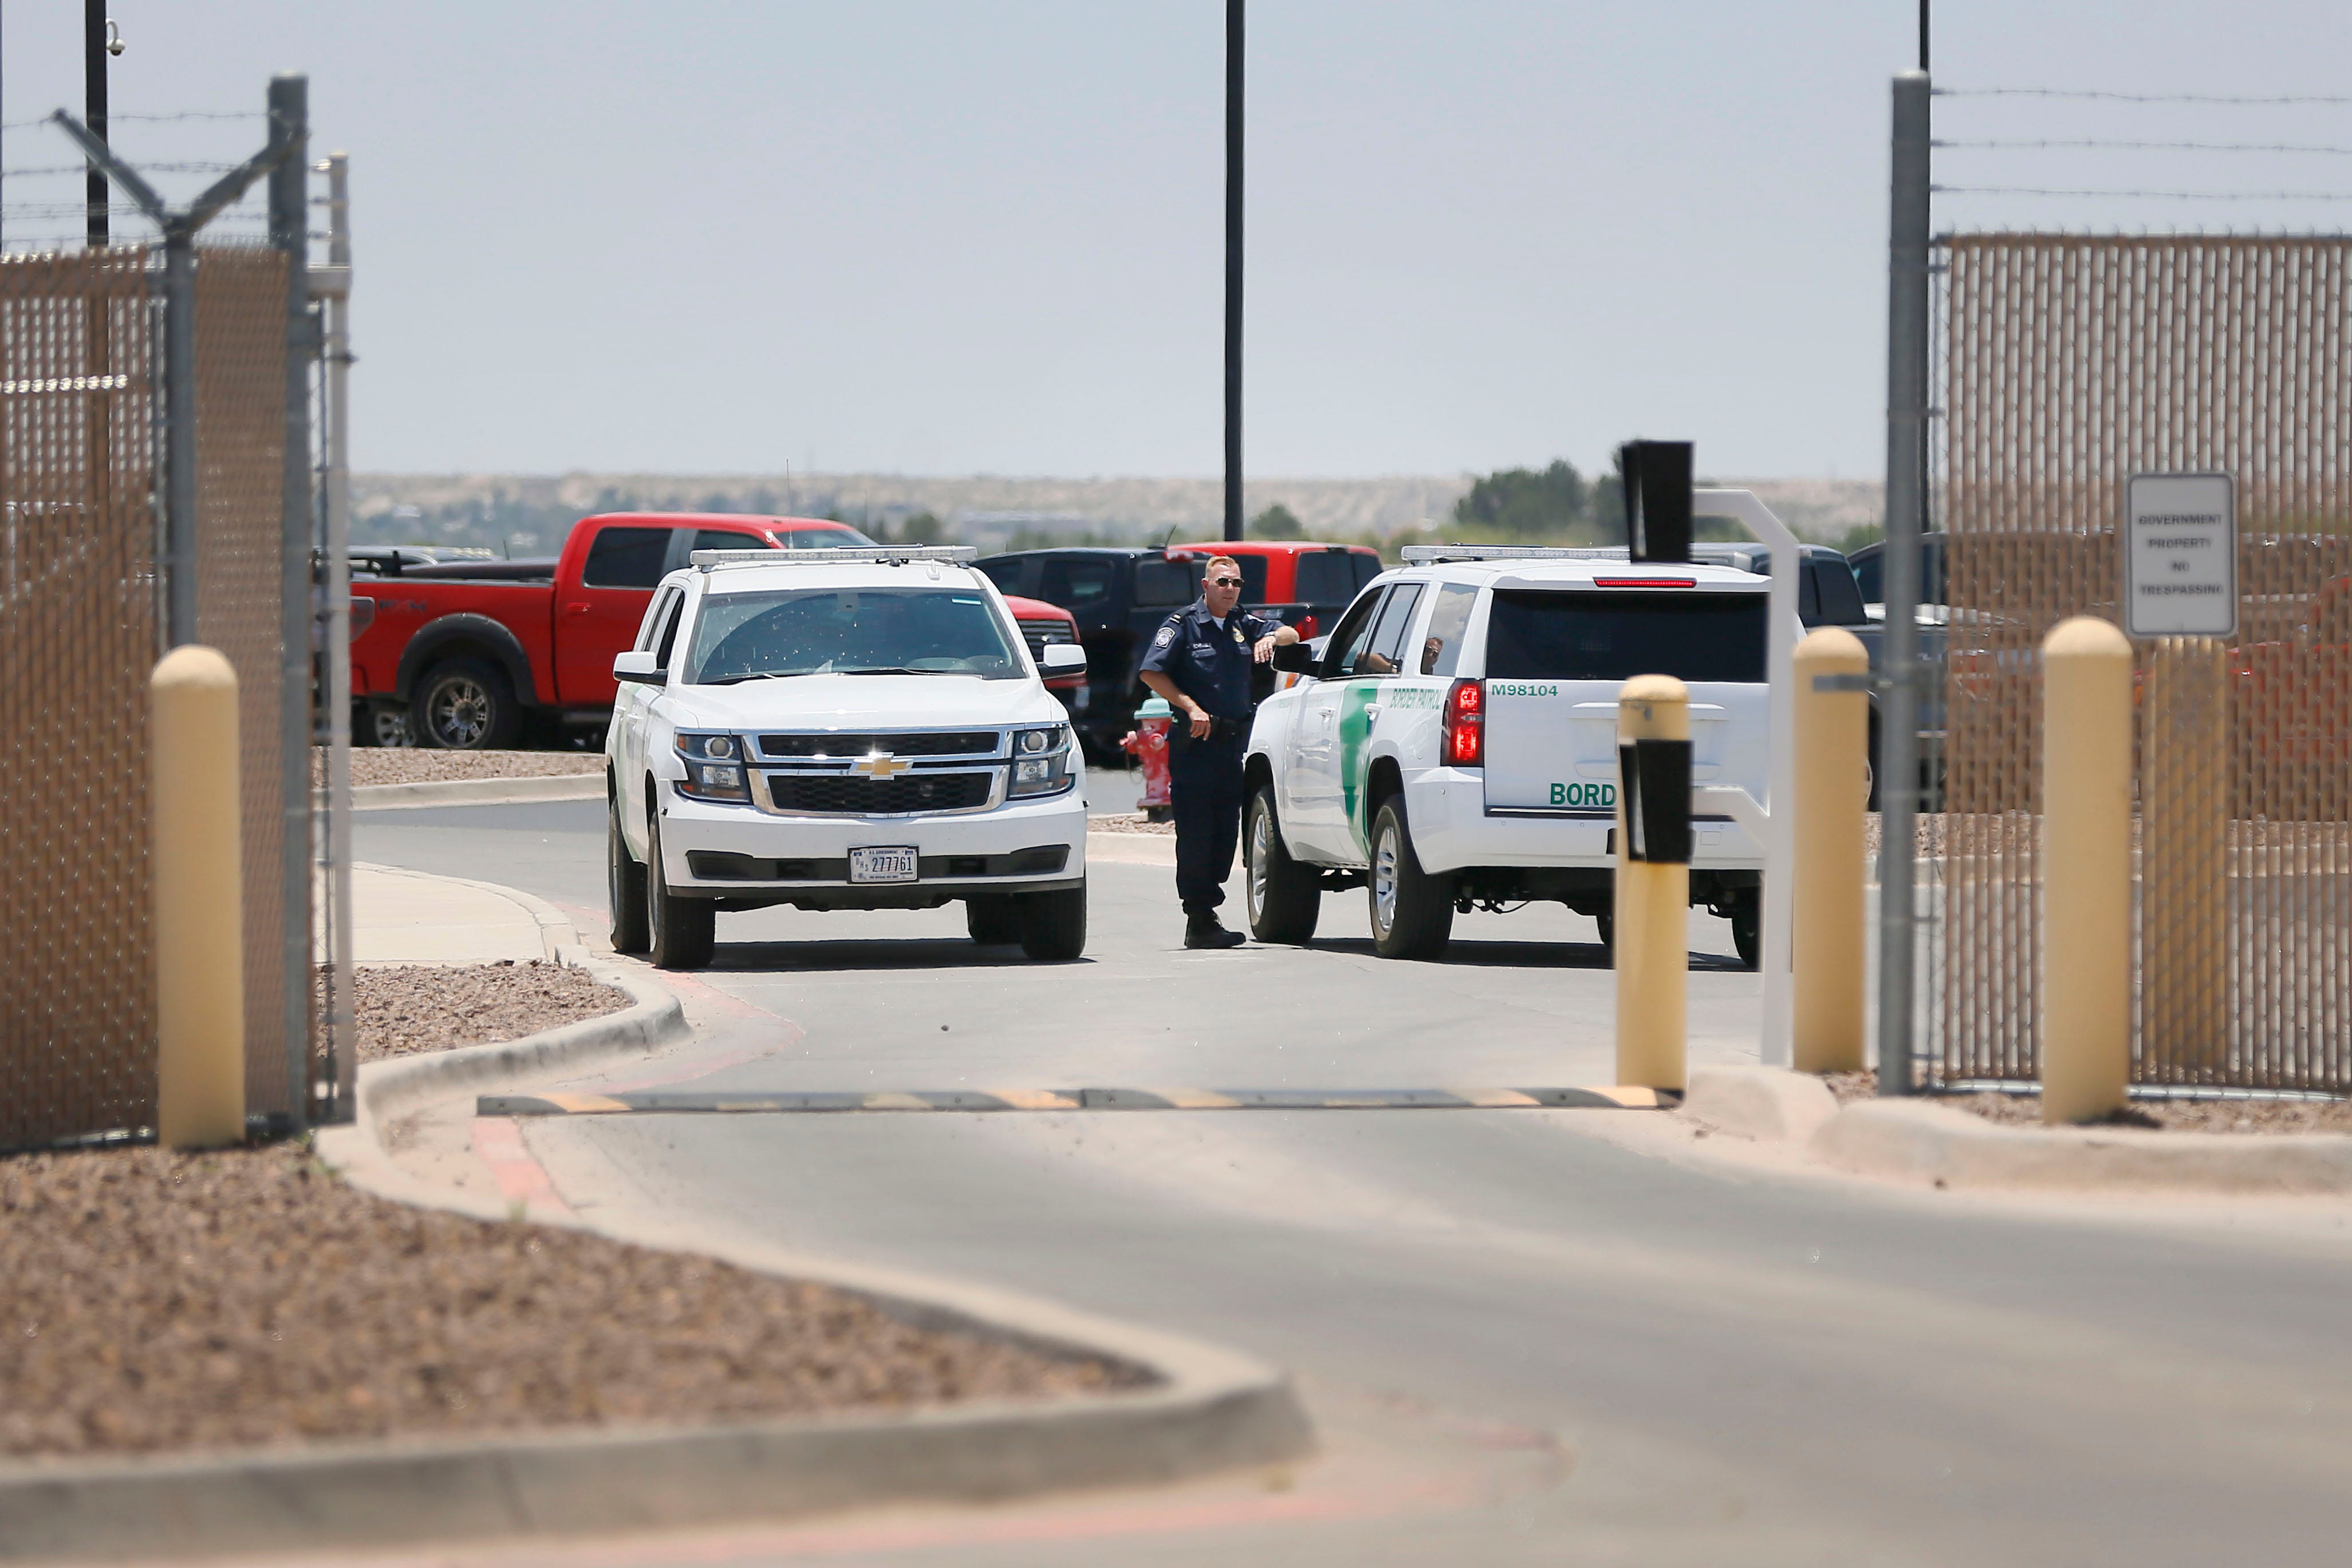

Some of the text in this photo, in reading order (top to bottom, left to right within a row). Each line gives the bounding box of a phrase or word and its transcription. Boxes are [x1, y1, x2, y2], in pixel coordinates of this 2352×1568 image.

[2139, 515, 2221, 525] GOVERNMENT
[2149, 538, 2212, 548] PROPERTY
[2172, 561, 2189, 572] NO
[2140, 585, 2224, 595] TRESPASSING
[1492, 684, 1558, 696] M98104
[1389, 688, 1442, 710] BORDER PATROL
[872, 857, 912, 872] 277761
